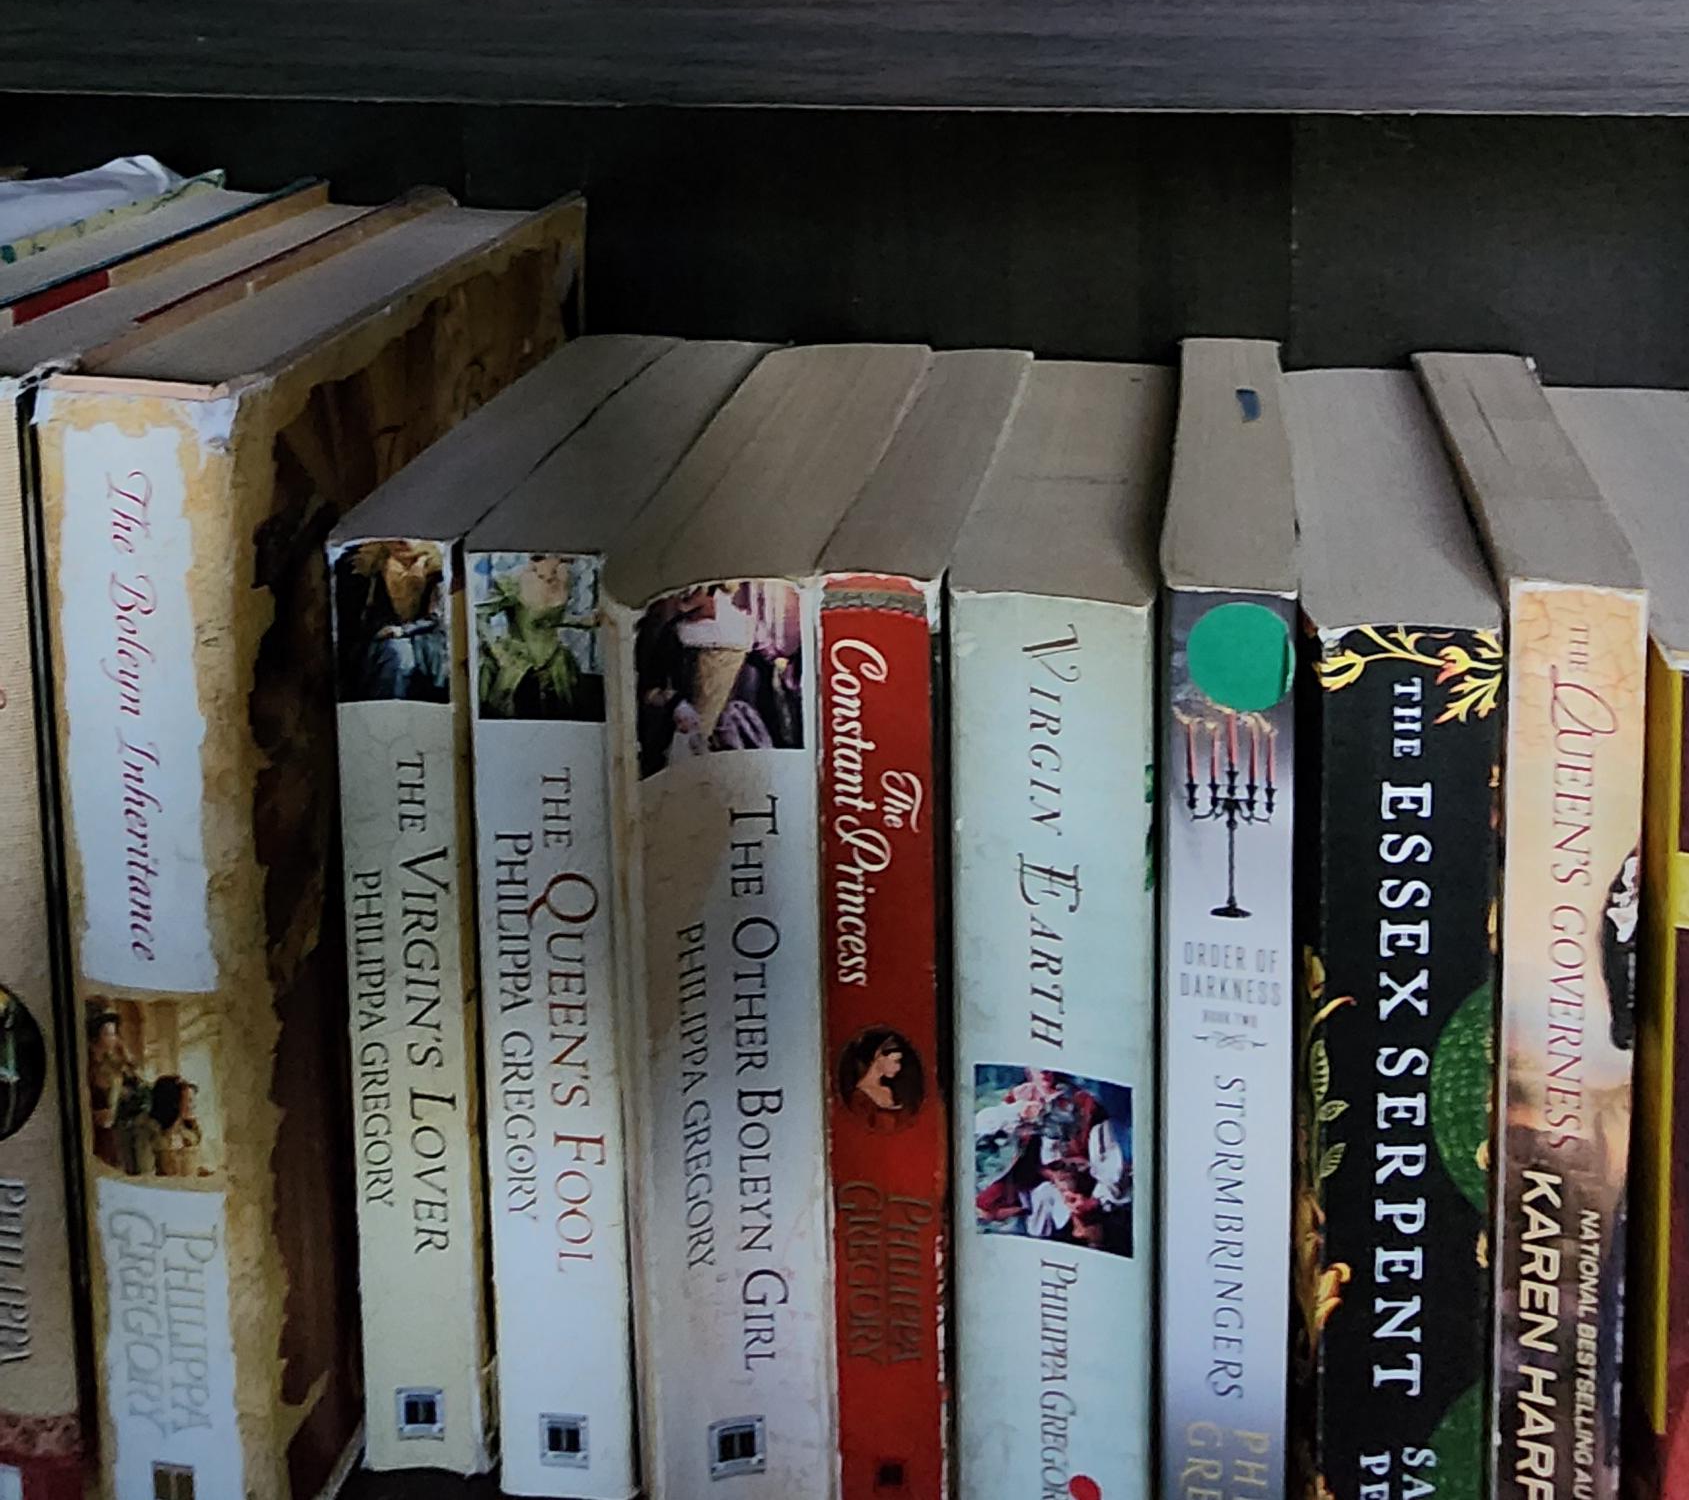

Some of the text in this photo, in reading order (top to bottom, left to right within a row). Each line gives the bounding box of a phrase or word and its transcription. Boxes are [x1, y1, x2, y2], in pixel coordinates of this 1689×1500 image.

[100, 469, 164, 963] The Boleyn Inheritance
[828, 637, 892, 988] Constant Princess
[880, 770, 923, 833] The
[1014, 621, 1083, 1052] VIRGIN EARTH
[351, 868, 396, 1209] PHILIPPA GREGORY
[395, 750, 458, 1255] THE VIRGIN'S LOVER
[494, 830, 538, 1222] PHILIPPA GREGORY
[527, 766, 607, 1275] THE QUEEN'S FOOL
[1180, 972, 1282, 1007] DARKNESS
[1184, 941, 1280, 973] ORDER OF
[1371, 676, 1434, 1398] THE ESSEX SERPENT
[1542, 623, 1617, 1152] THE QUEEN'S GOVERNESS
[675, 920, 717, 1271] PHILIPPA GREGORY
[727, 794, 790, 1372] THE OTHER BOLEYN GIRL
[1206, 1073, 1248, 1400] STORMBRINGERS
[108, 1208, 169, 1440] GREGORY
[161, 1222, 219, 1433] PHILIPPA
[1039, 1258, 1080, 1383] PHILIPPA
[1517, 1168, 1563, 1354] KAREN
[1572, 1322, 1599, 1466] BESTSELLING
[1577, 1208, 1601, 1320] NATIONAL
